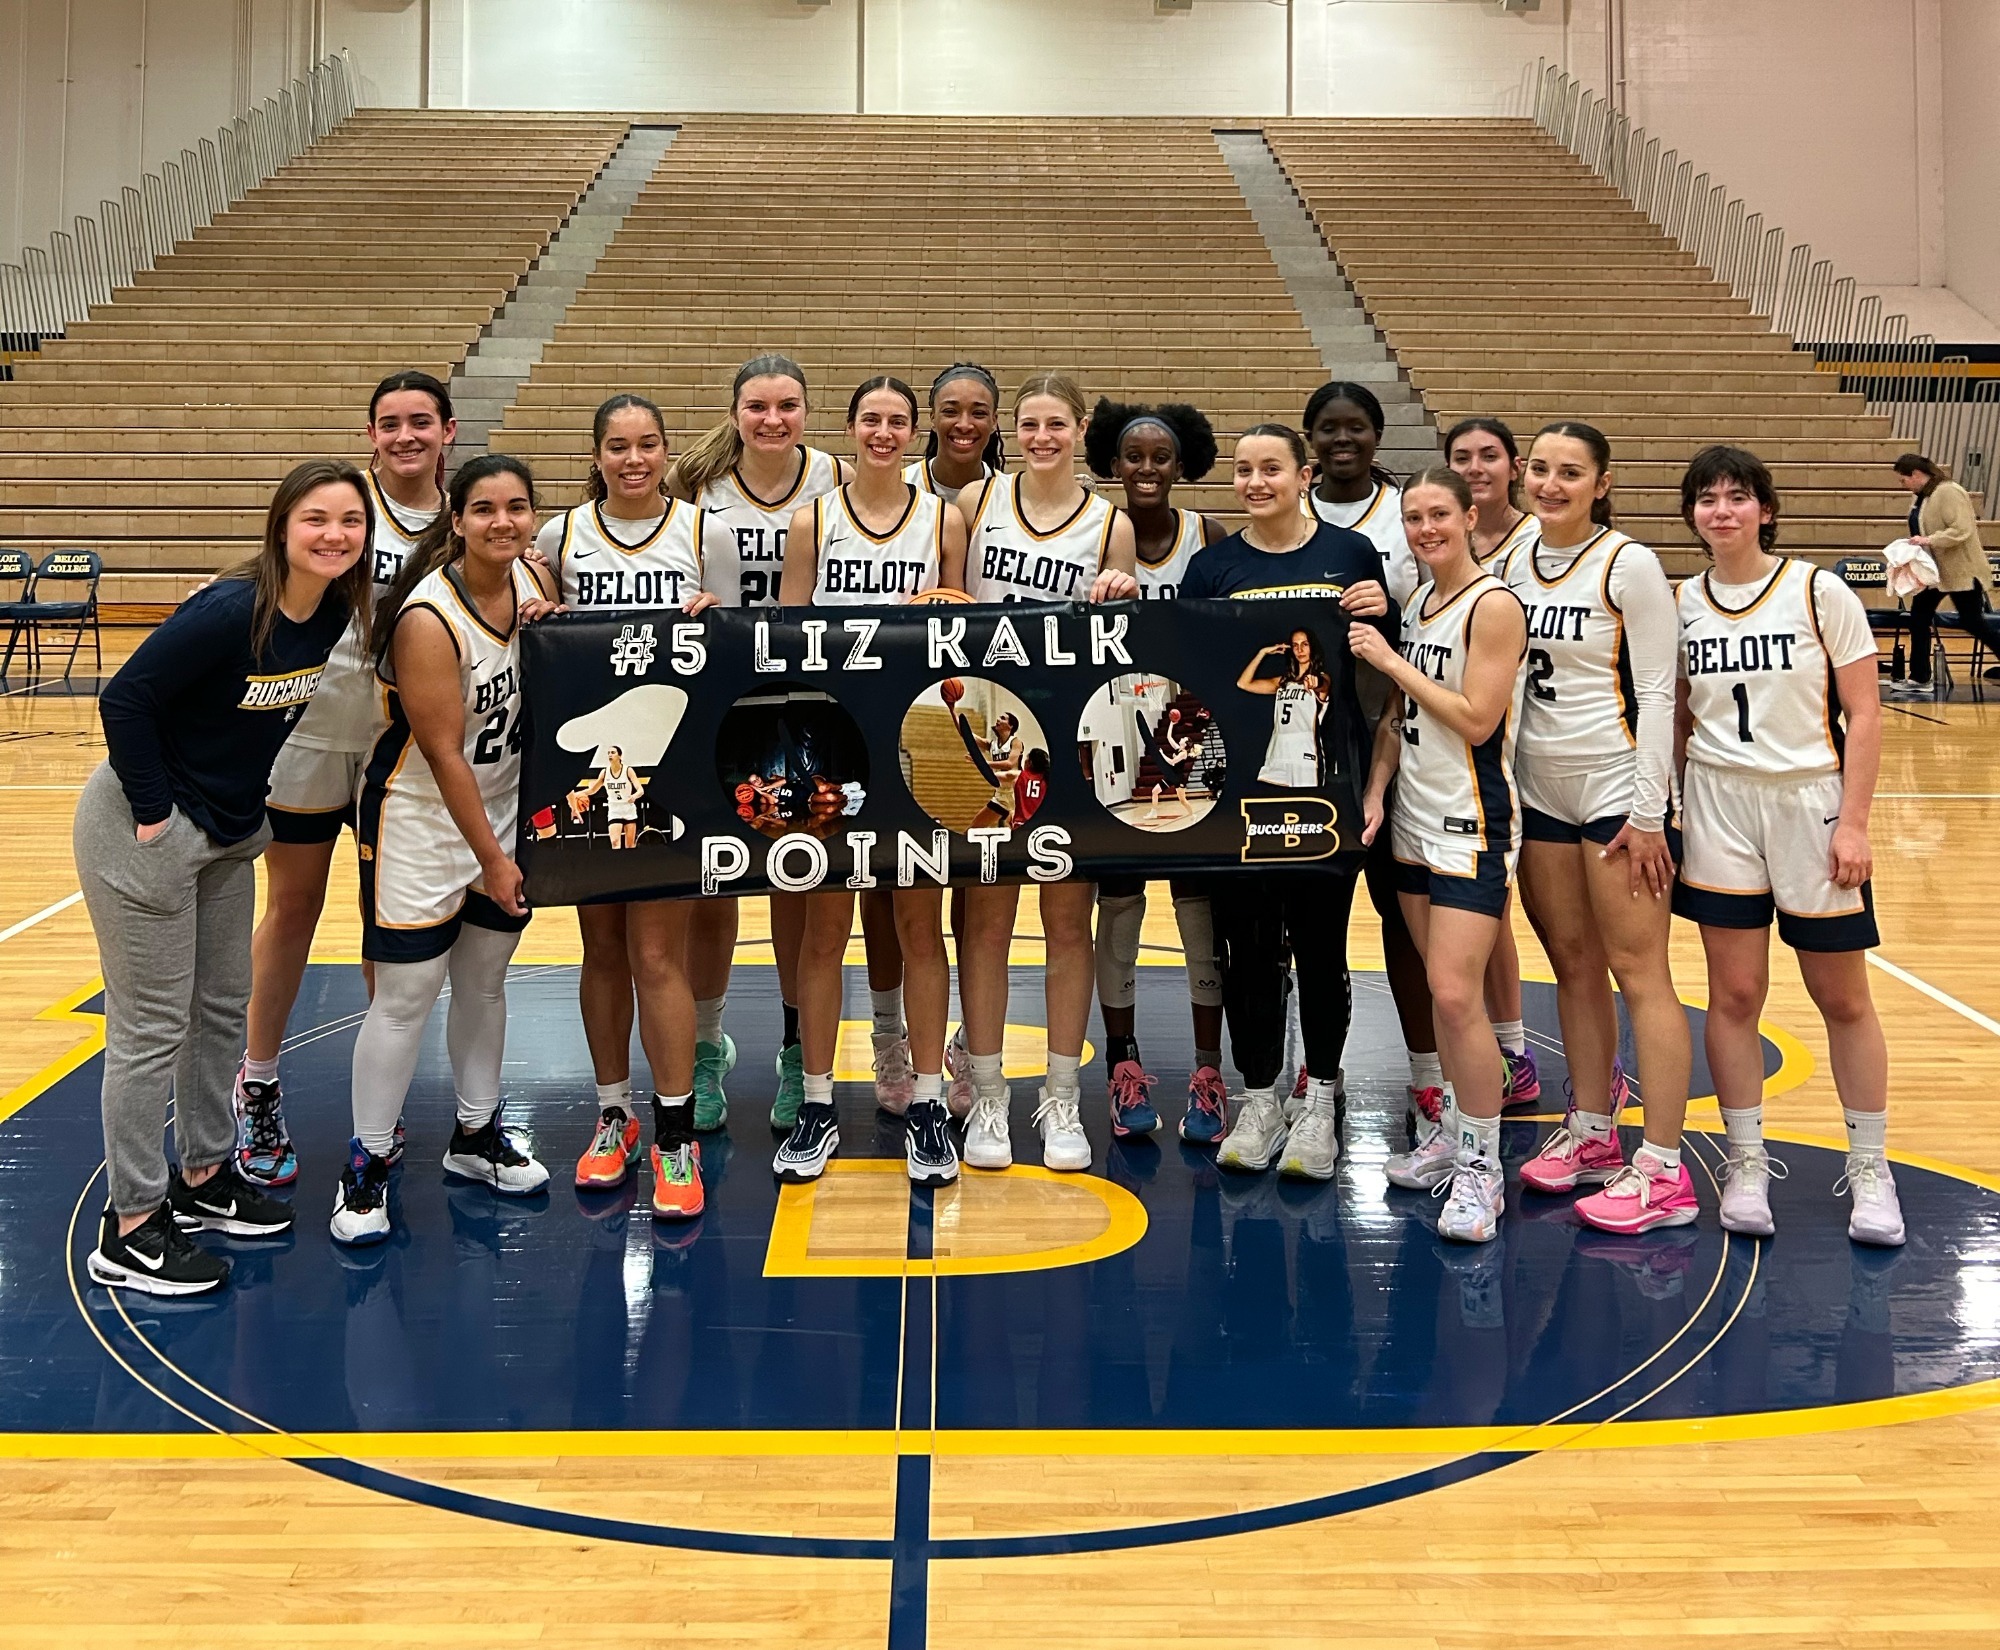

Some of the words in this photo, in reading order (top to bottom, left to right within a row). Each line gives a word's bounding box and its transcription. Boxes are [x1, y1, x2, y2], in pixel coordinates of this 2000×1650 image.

[0, 555, 21, 563] OIT
[53, 555, 90, 563] BELOIT
[736, 528, 788, 562] ELO
[47, 565, 91, 573] COLLEGE
[825, 559, 926, 596] BELOIT
[982, 546, 1085, 597] BELOIT
[1844, 573, 1886, 581] COLLEGE
[1845, 563, 1881, 571] BELOIT
[577, 570, 685, 606] BELOIT
[1523, 604, 1592, 641] LOIT
[610, 622, 707, 677] #5
[755, 619, 883, 673] LIZ
[927, 614, 1133, 669] KALK
[1687, 633, 1796, 676] BELOIT
[473, 666, 517, 714] BEL
[1281, 703, 1293, 725] 5
[1731, 683, 1755, 742] 1
[1026, 779, 1040, 798] 15
[1247, 823, 1324, 836] BUCCANEERS
[702, 825, 1074, 895] POINTS
